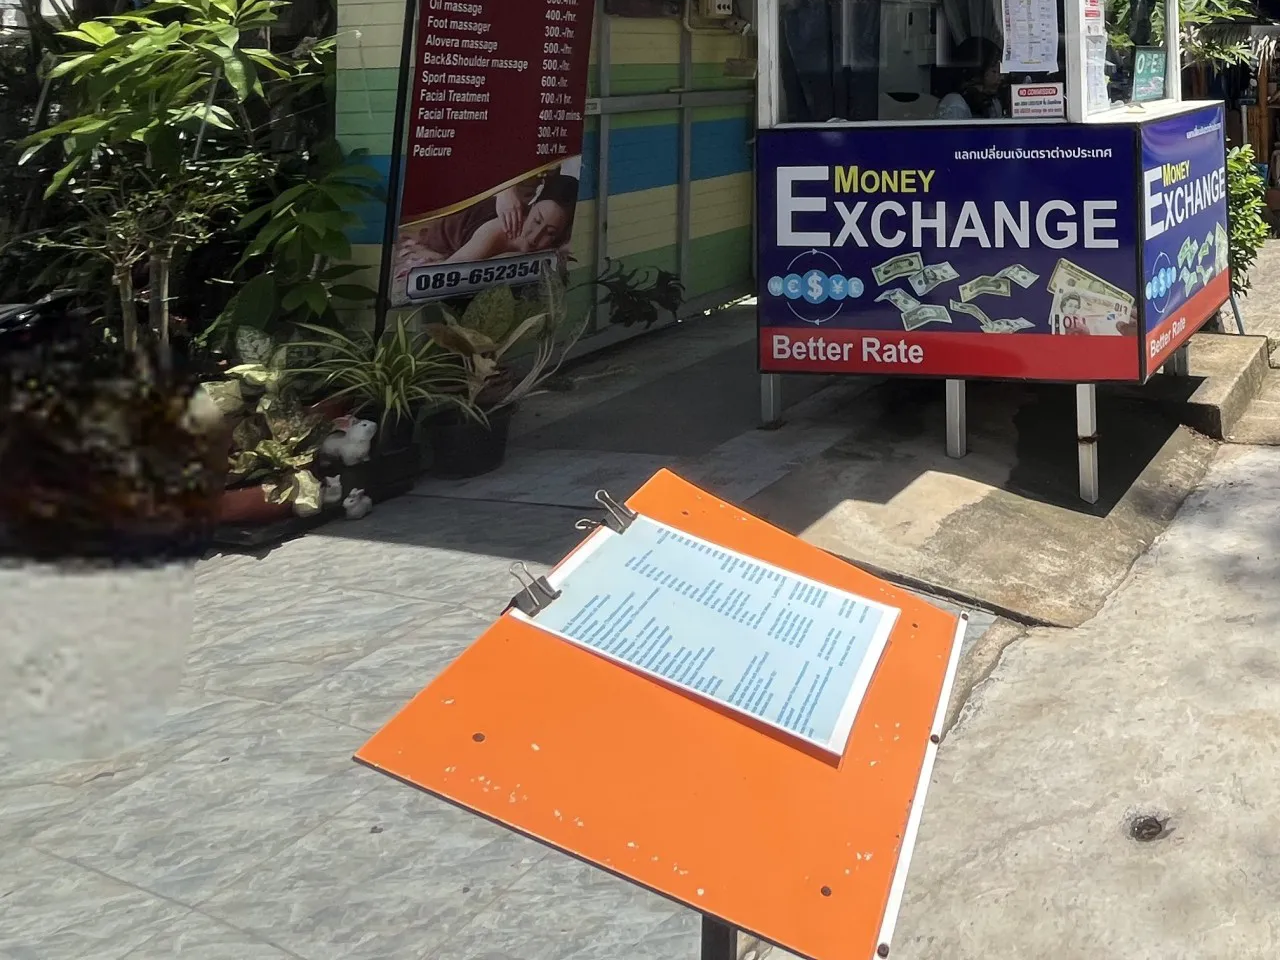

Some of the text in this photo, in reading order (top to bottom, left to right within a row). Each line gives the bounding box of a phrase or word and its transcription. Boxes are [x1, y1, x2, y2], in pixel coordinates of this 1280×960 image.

[444, 1, 482, 16] massage
[427, 15, 491, 35] Foot massager
[425, 34, 498, 53] Alovera massage
[424, 52, 528, 72] Back&Shoulder massage
[422, 71, 486, 88] Sport massage
[420, 89, 490, 103] Facial Treatment
[418, 107, 488, 121] Facial Treatment
[416, 126, 455, 139] Manicure
[413, 144, 452, 157] Pedicure
[954, 145, 1112, 161] แลกเปลี่ยนเงินตราต่างประเทศ
[834, 166, 936, 193] MONEY
[1162, 160, 1190, 187] MONEY
[776, 166, 1119, 248] EXCHANGE
[1144, 166, 1226, 240] EXCHANGE
[1150, 317, 1186, 358] Better Rate
[772, 334, 924, 364] Better Rate
